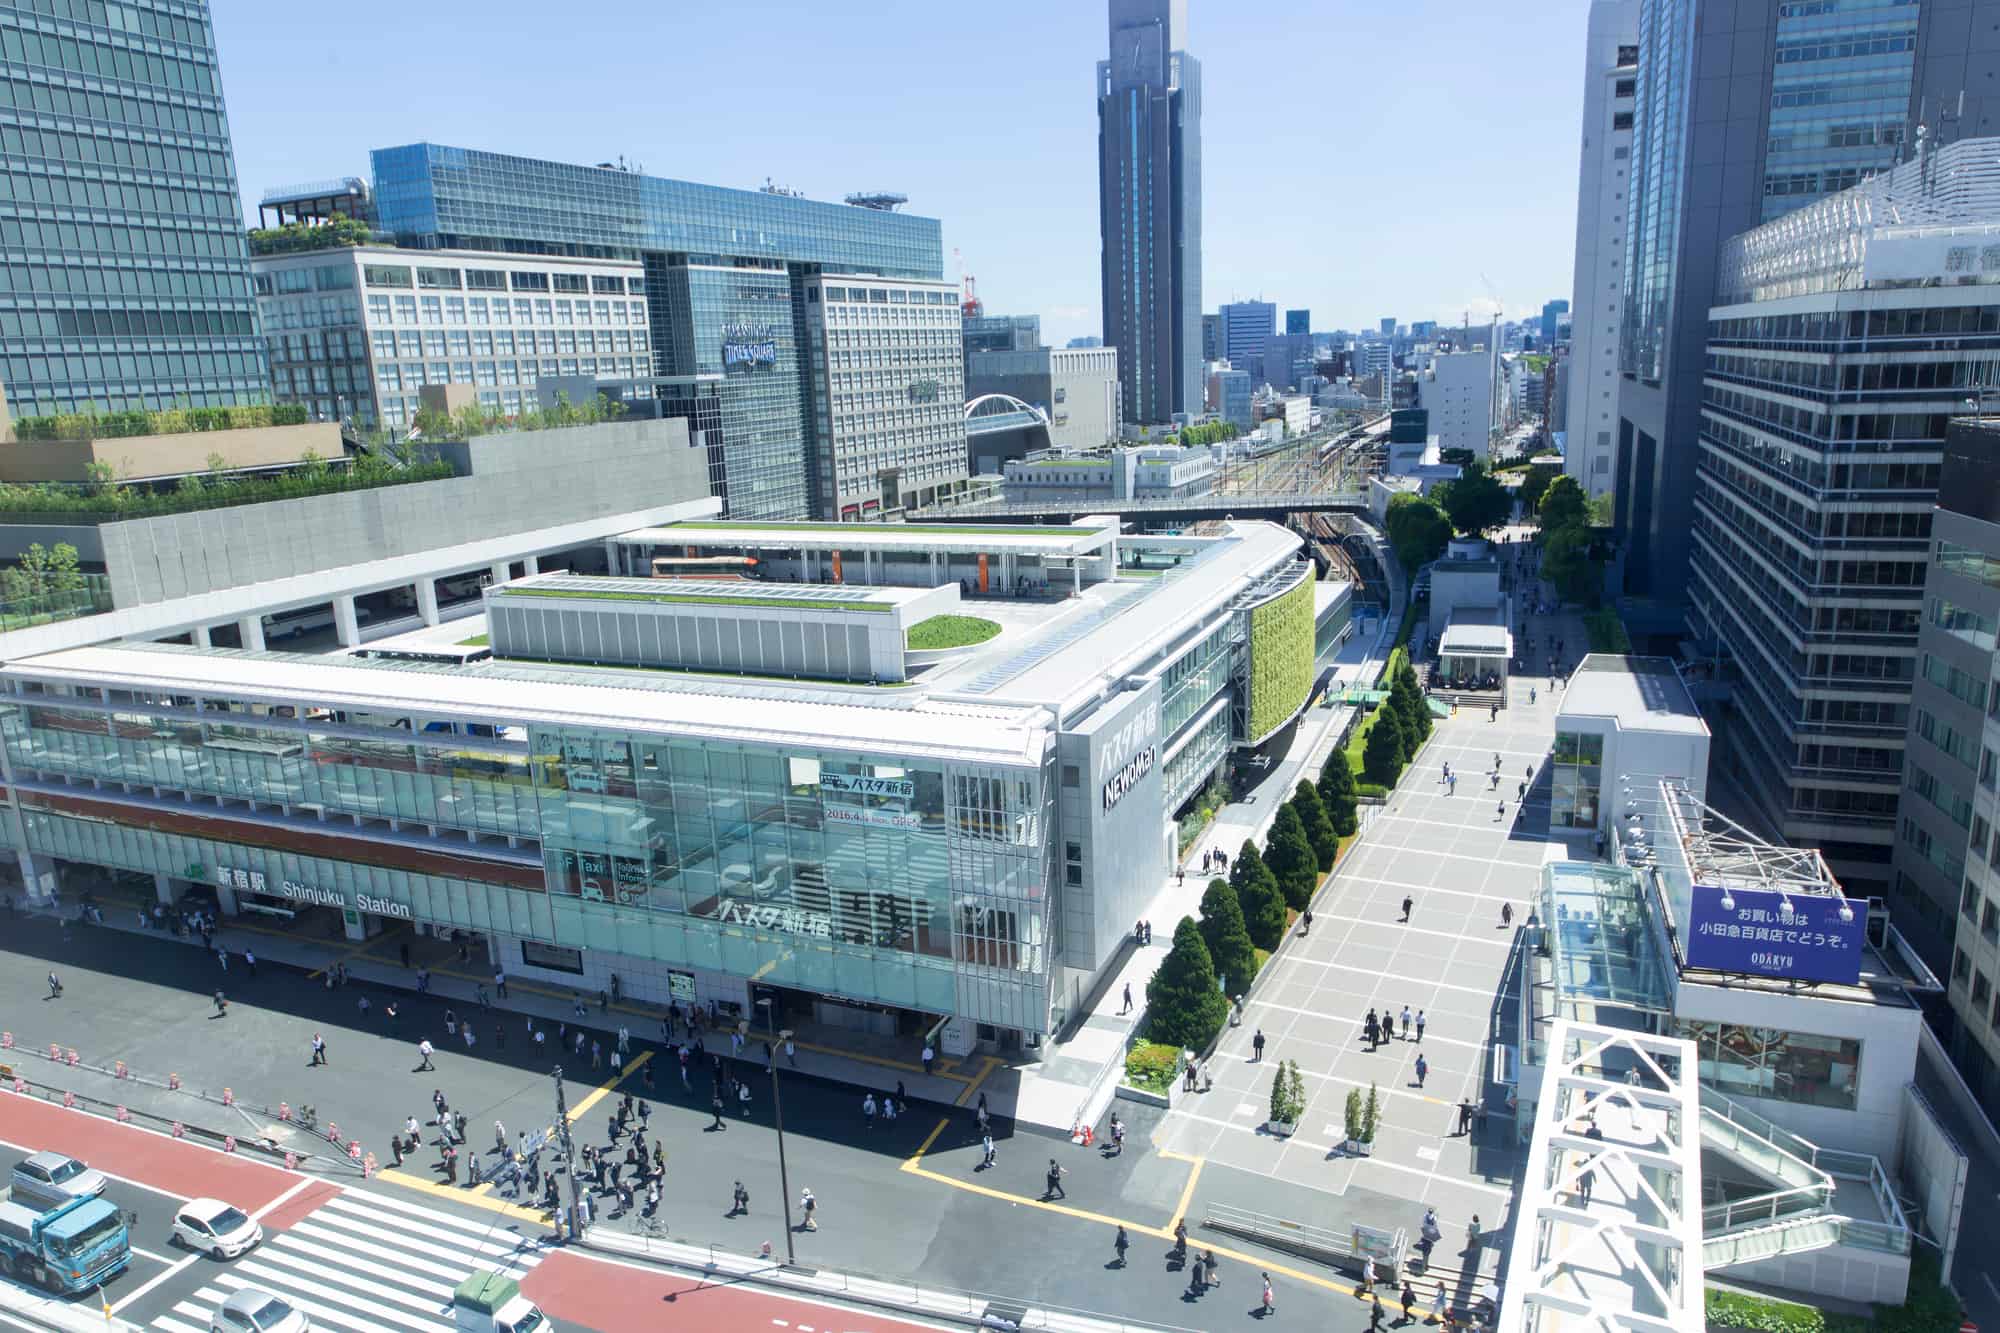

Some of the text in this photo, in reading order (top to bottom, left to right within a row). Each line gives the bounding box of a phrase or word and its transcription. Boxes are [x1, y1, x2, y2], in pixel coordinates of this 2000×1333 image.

[851, 778, 913, 796] バスタ新宿
[216, 866, 265, 891] 新宿駅
[283, 881, 410, 918] Shinjuku Station
[719, 899, 831, 937] バスタ新宿
[1738, 909, 1809, 926] お買い物は
[1699, 922, 1849, 949] 小田急百貨店でどうぞ。
[1751, 952, 1793, 968] ODAKYU
